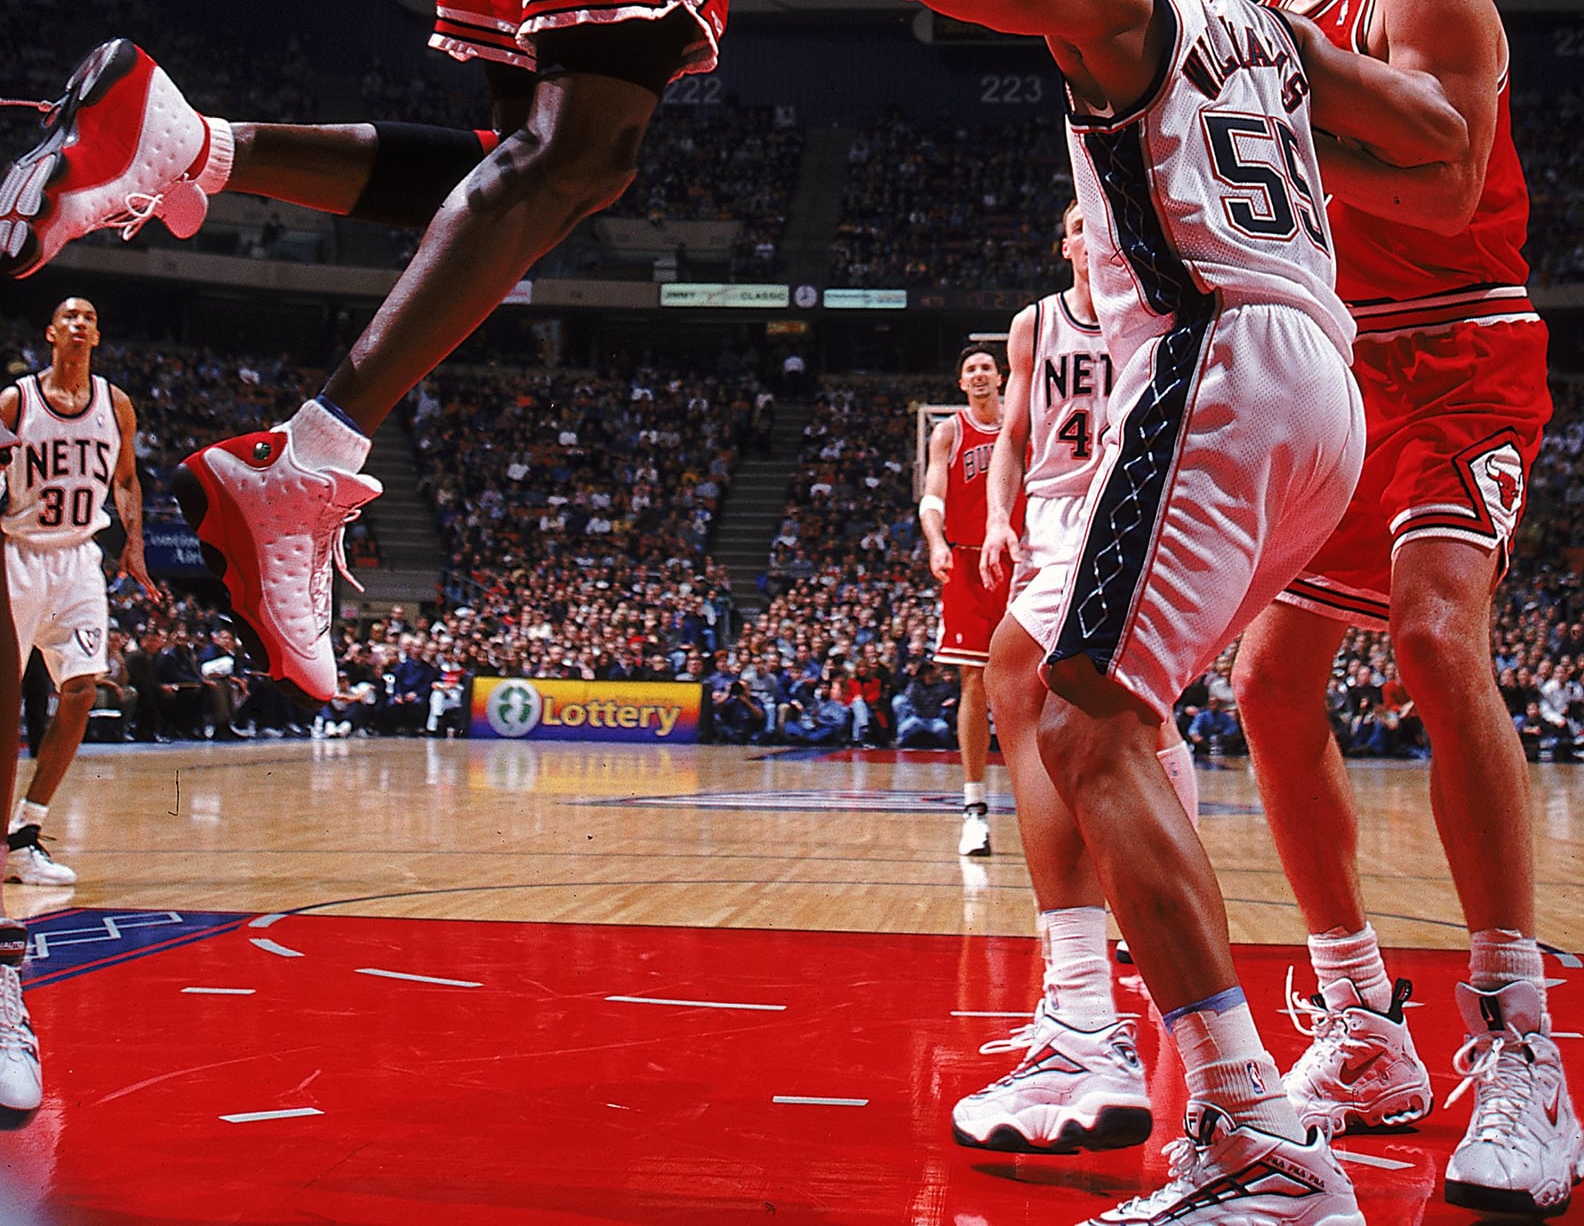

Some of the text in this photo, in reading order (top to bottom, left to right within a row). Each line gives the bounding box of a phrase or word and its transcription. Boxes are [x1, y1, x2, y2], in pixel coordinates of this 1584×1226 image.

[981, 77, 1042, 103] 223
[1199, 110, 1331, 260] 55
[1044, 351, 1113, 412] NET
[1057, 409, 1111, 460] 4
[26, 439, 110, 489] NETS
[38, 487, 95, 528] 30
[541, 696, 682, 737] Lottery
[1288, 1163, 1306, 1178] FILA
[1309, 1173, 1325, 1188] FILA
